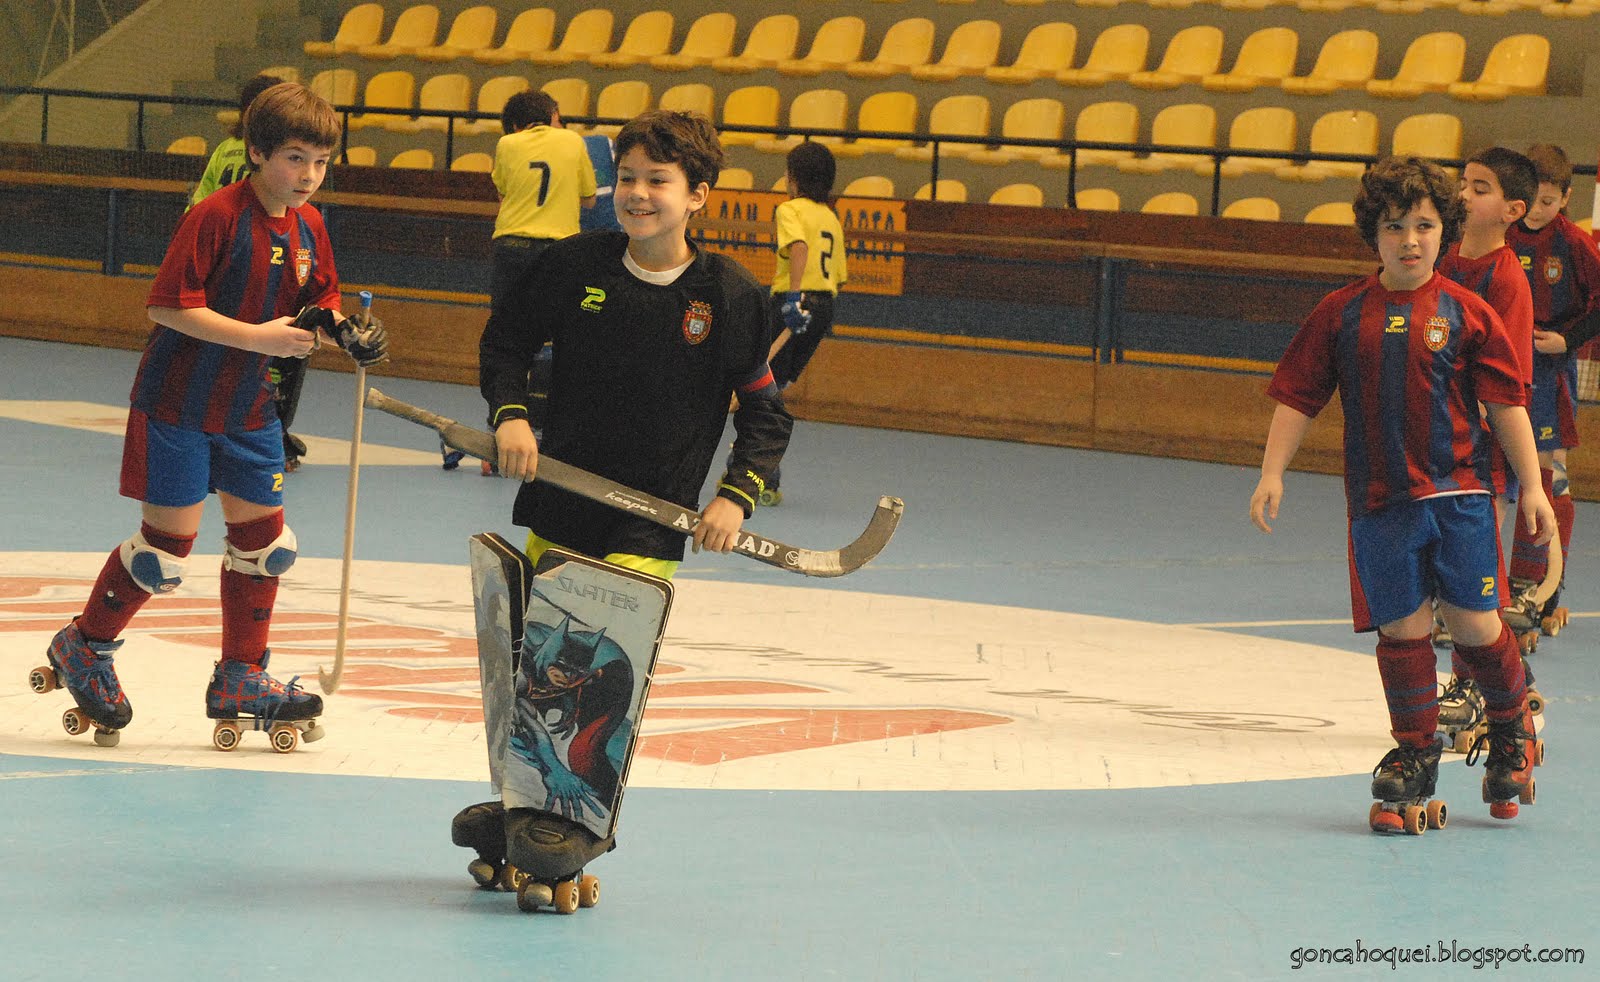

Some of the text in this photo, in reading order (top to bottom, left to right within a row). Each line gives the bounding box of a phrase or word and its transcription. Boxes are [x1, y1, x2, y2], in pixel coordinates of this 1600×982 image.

[528, 161, 551, 208] 7
[820, 230, 834, 280] 2
[604, 491, 658, 515] keeper
